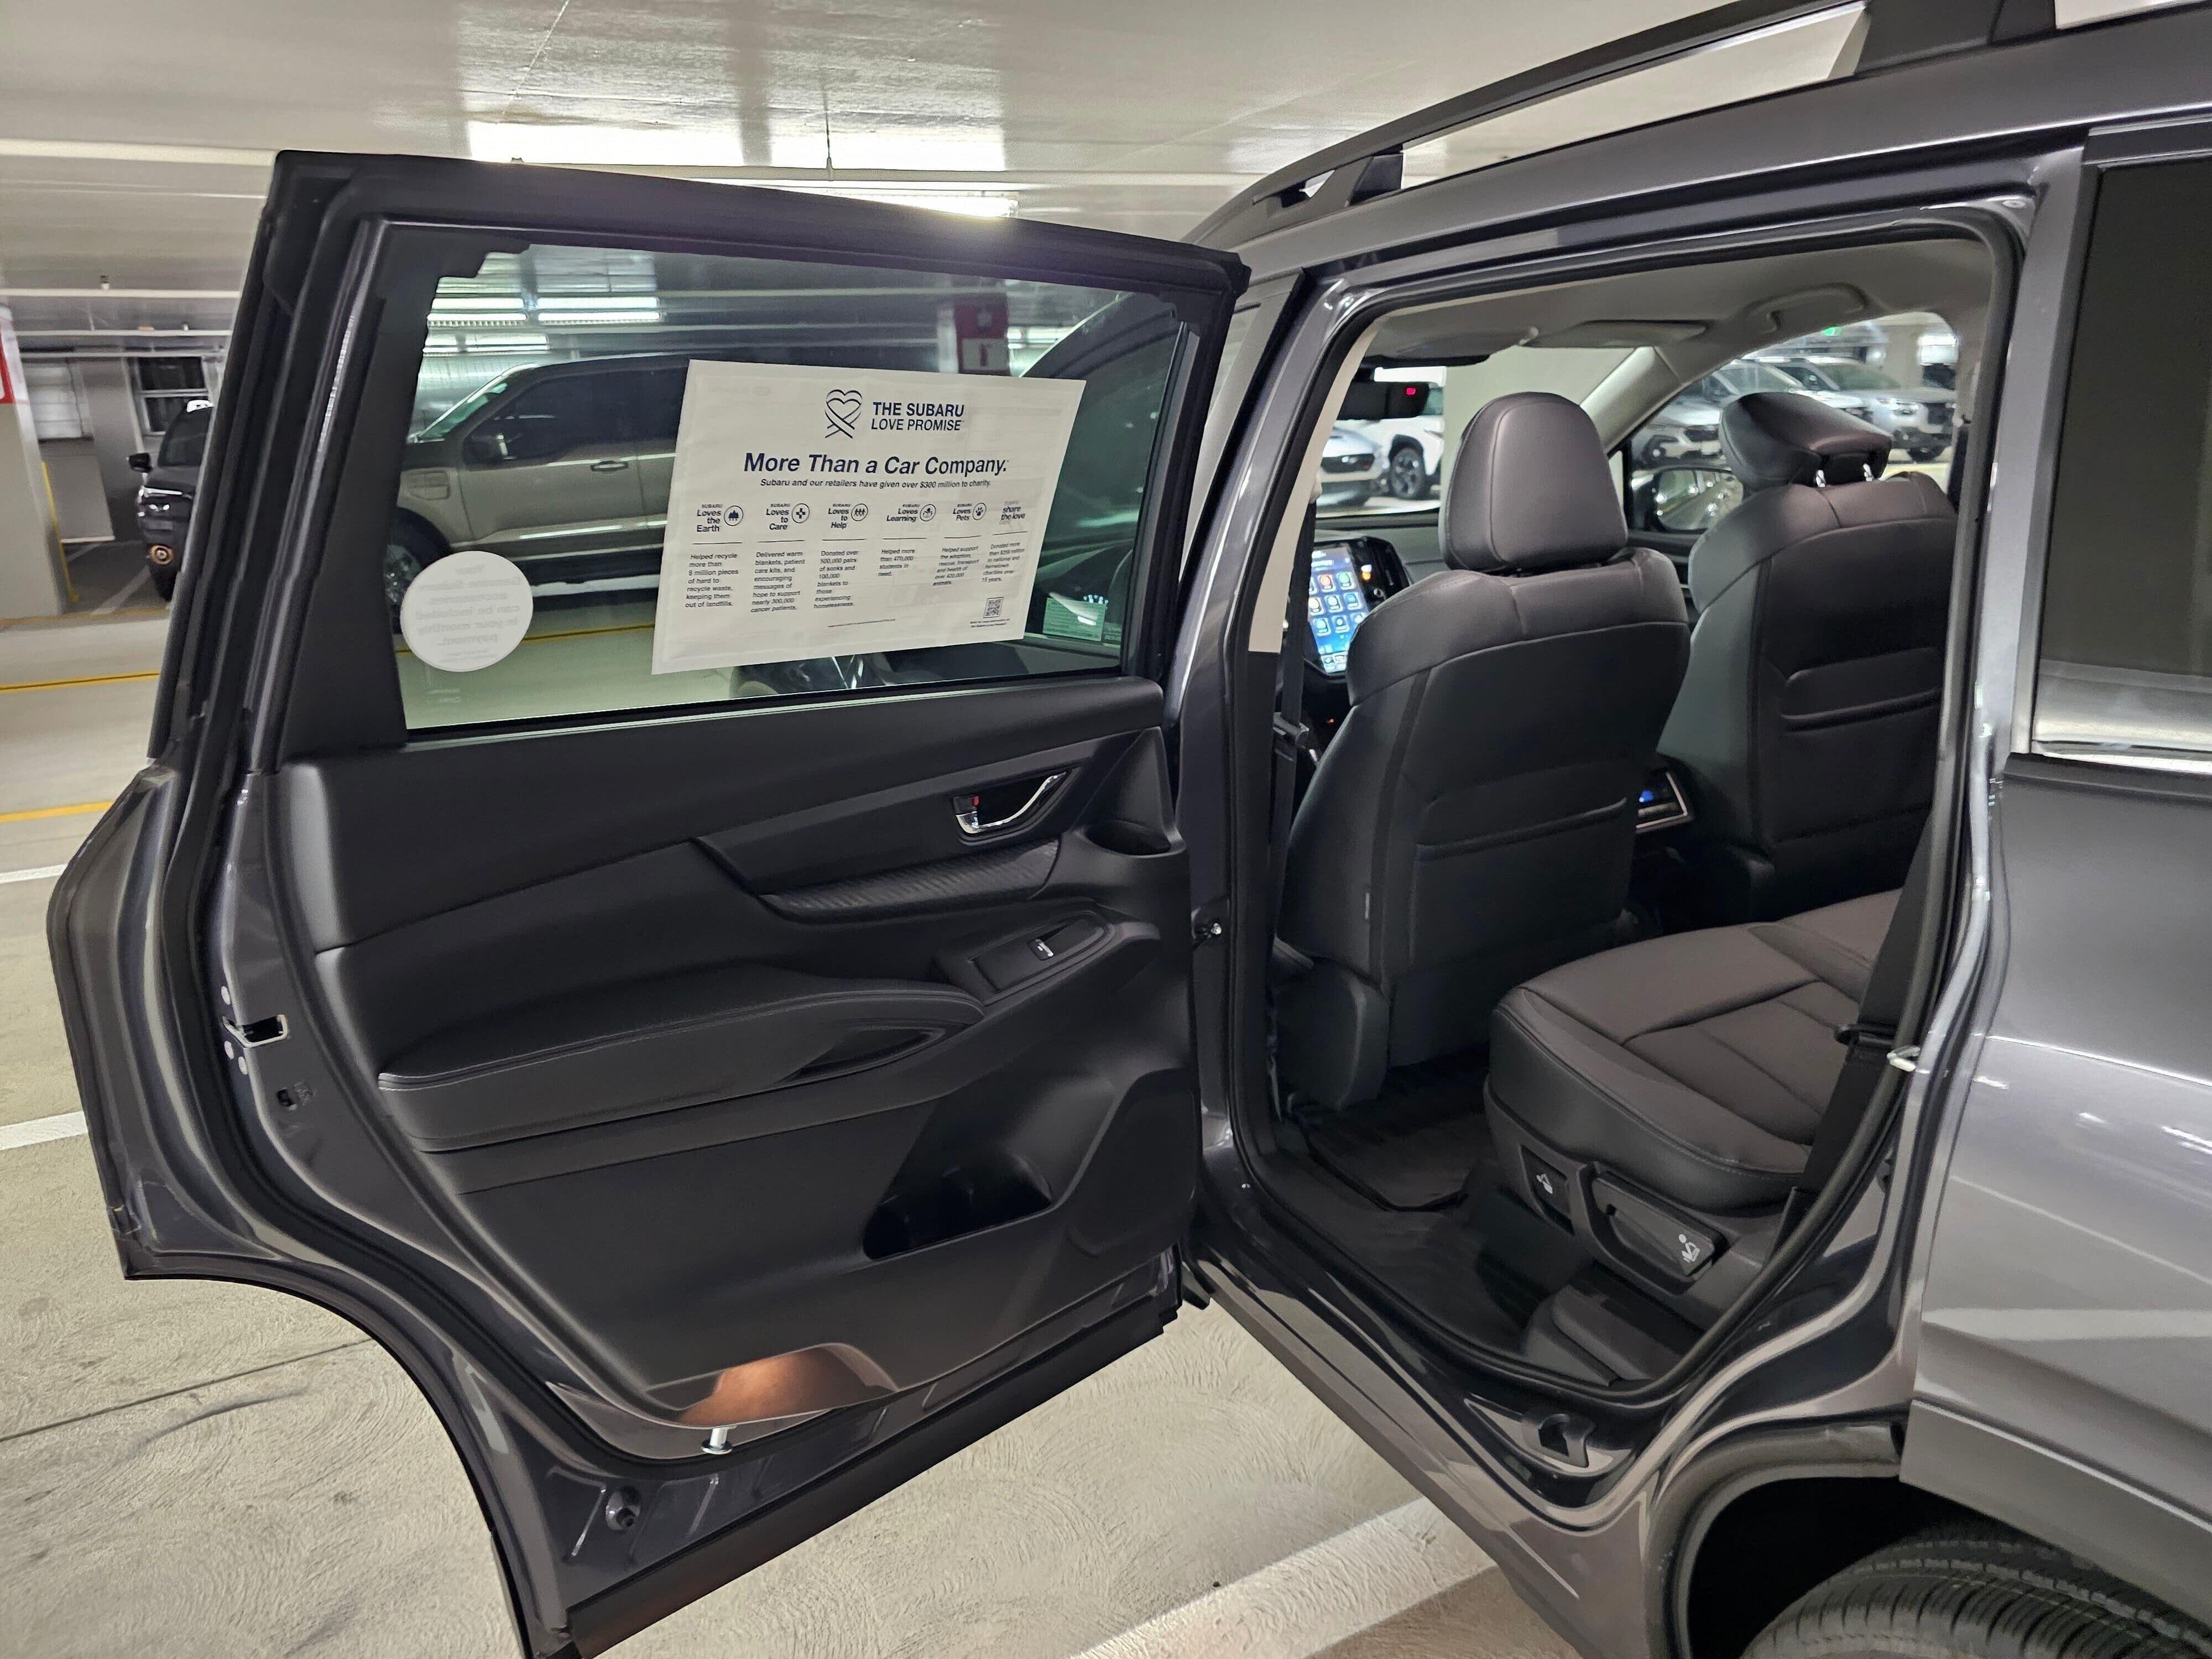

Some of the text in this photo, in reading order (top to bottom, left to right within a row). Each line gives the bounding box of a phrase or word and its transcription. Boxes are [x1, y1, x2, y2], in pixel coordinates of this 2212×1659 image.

[873, 402, 964, 417] THE SUBARU
[871, 419, 962, 431] LOVE PROMISE
[744, 452, 1006, 477] More Than a Car Company.
[879, 481, 900, 489] given
[969, 479, 991, 488] charity.
